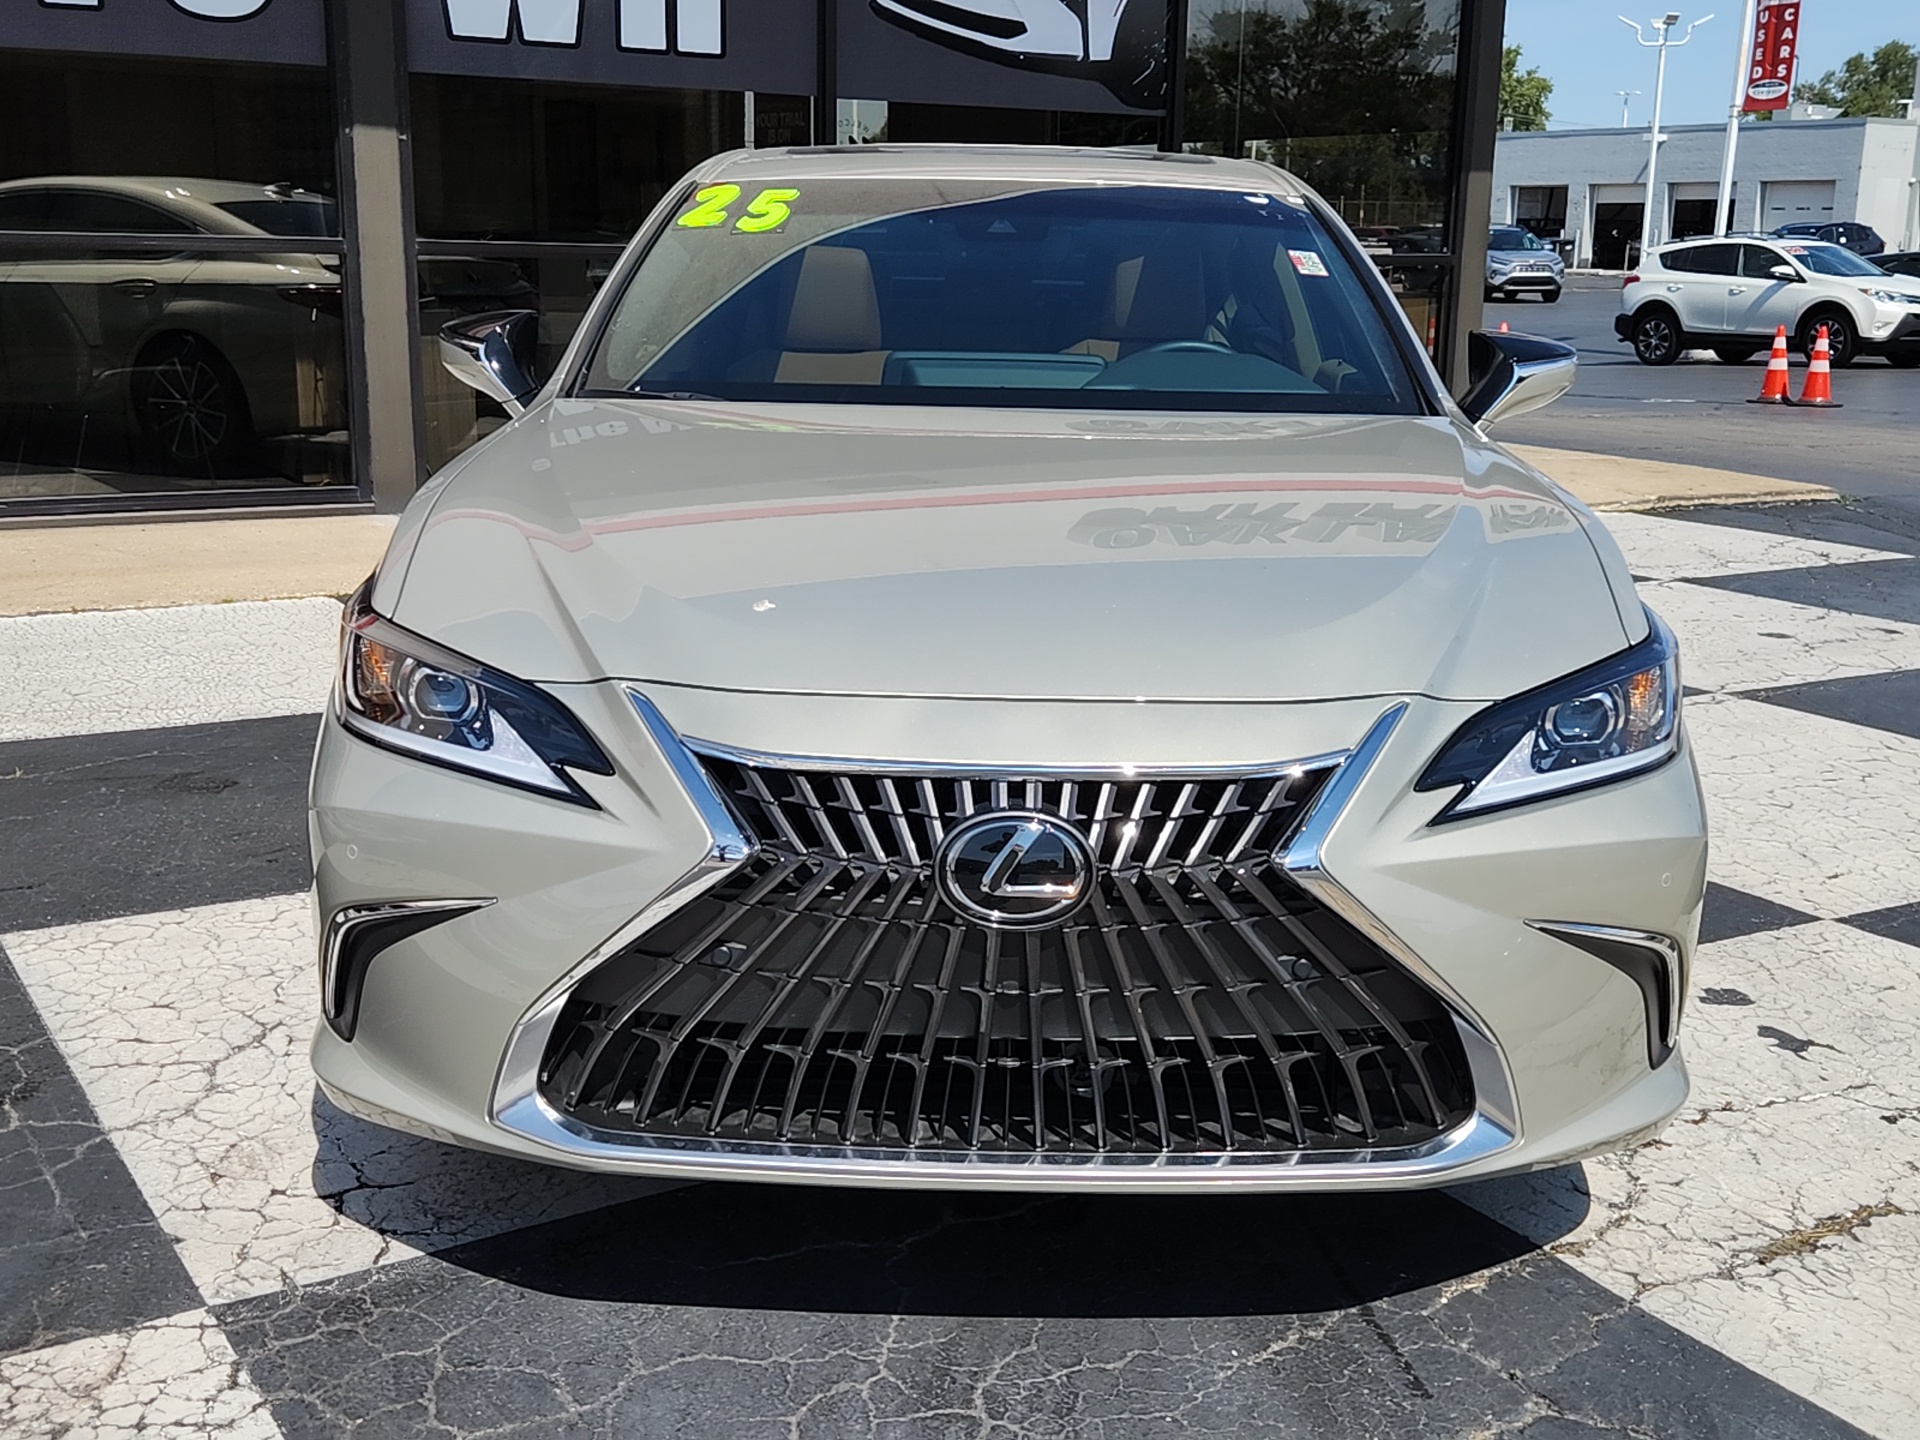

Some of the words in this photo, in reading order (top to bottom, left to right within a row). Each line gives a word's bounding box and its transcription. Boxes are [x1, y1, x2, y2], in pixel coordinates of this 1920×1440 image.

[1752, 11, 1769, 79] USED
[1777, 8, 1796, 78] CARS
[677, 184, 800, 232] 25
